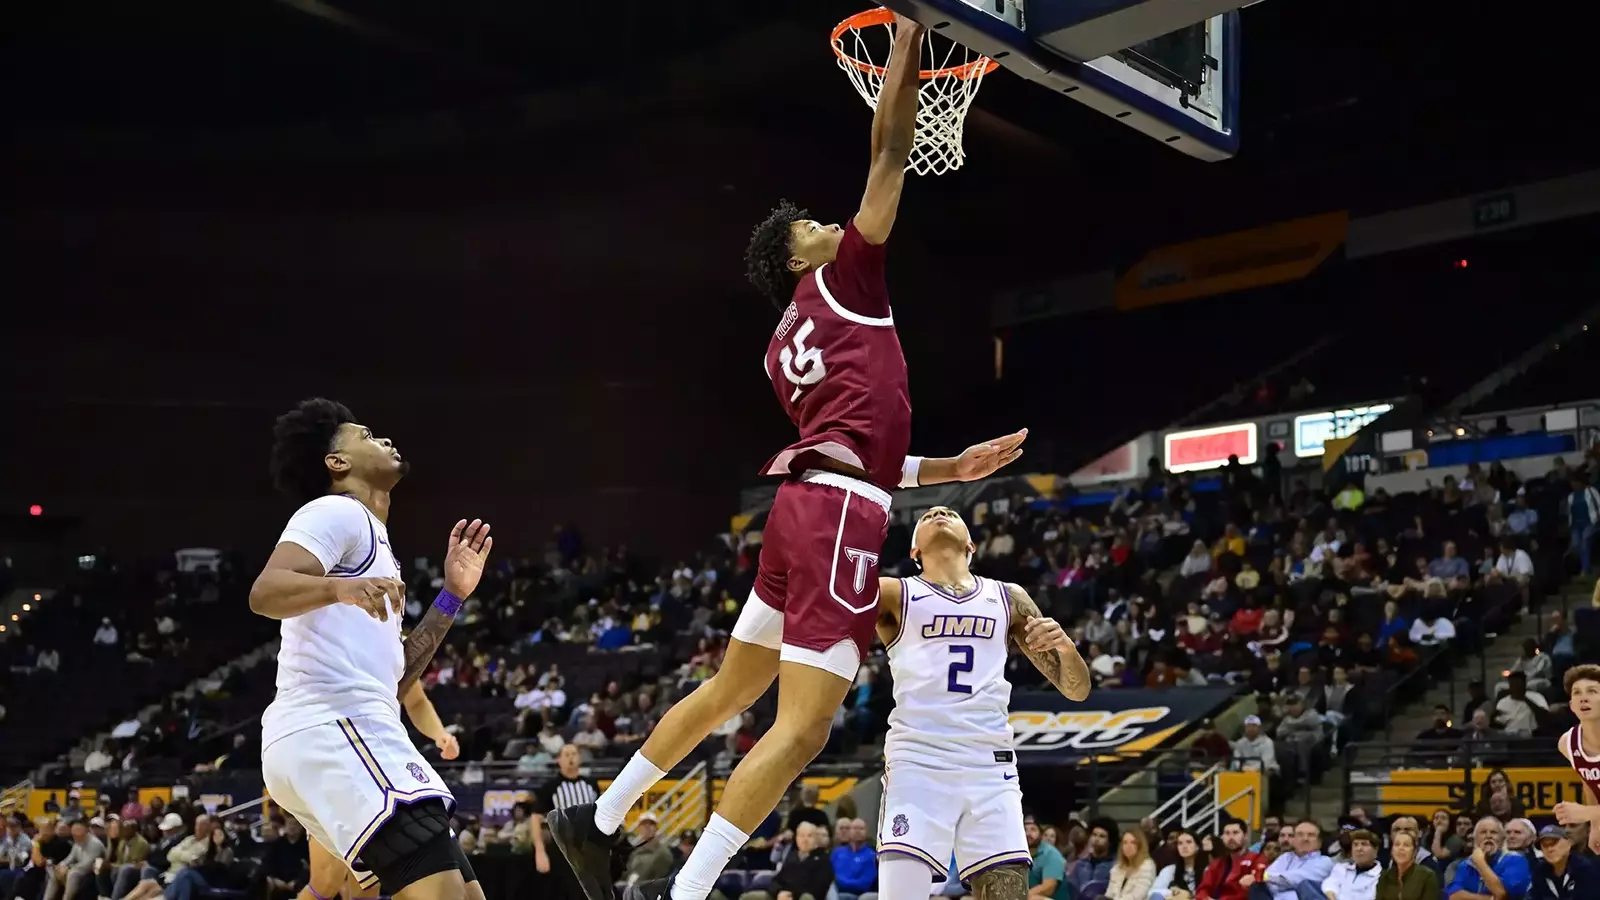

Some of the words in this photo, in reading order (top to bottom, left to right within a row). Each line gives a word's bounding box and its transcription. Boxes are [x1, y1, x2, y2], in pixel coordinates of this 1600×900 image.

[779, 316, 827, 402] 15
[844, 546, 879, 594] T
[922, 614, 997, 640] JMU
[947, 645, 974, 694] 2
